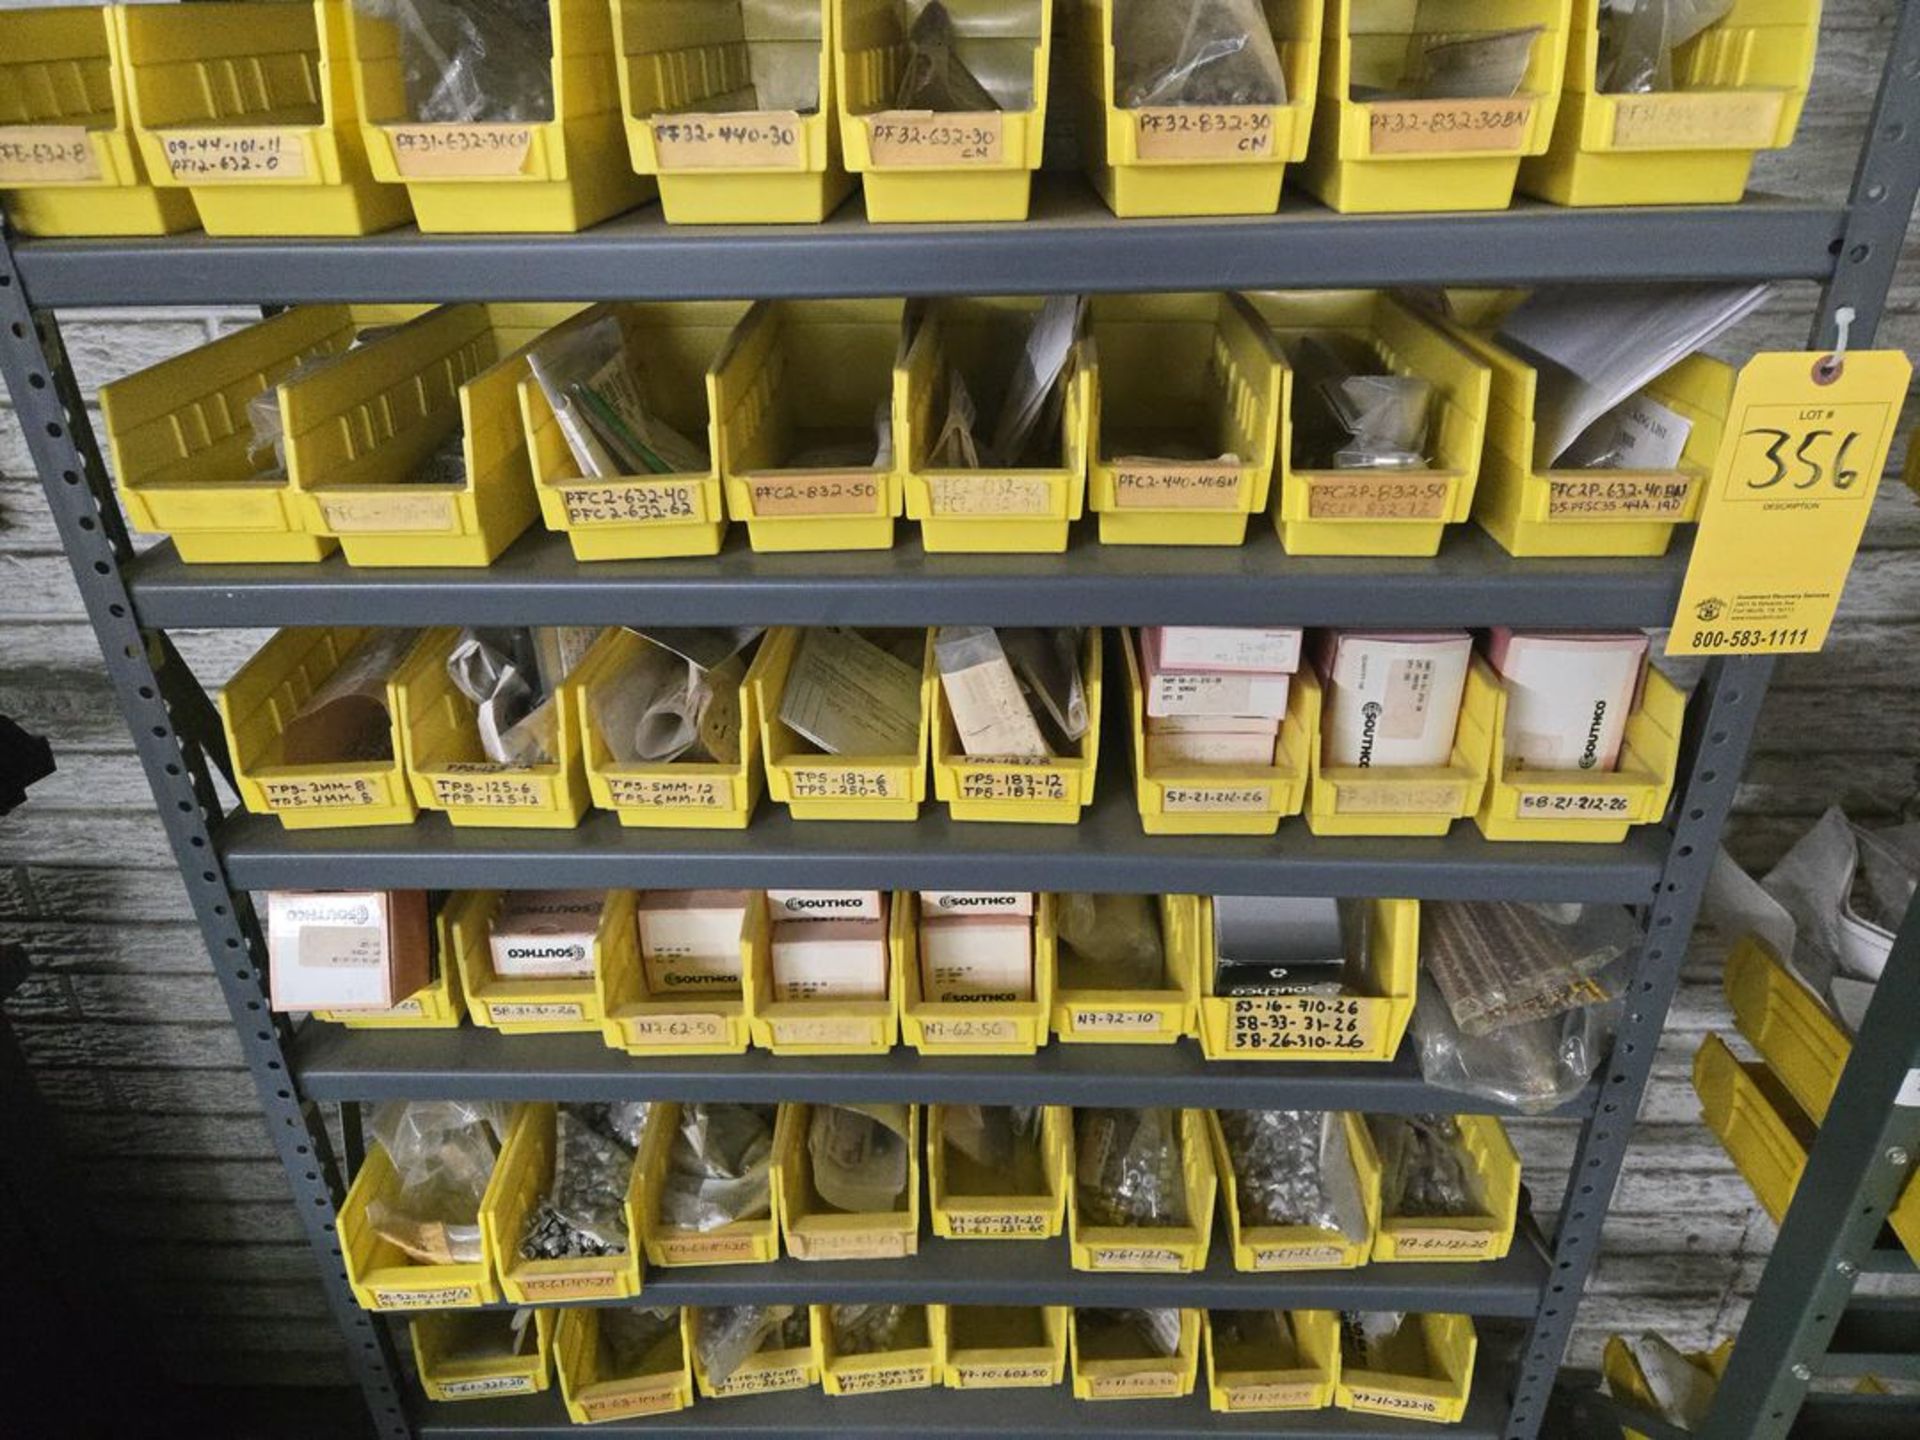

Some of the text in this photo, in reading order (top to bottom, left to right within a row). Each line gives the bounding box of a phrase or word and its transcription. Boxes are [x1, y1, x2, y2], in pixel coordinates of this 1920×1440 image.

[1799, 410, 1826, 421] LOT
[1744, 428, 1861, 490] 356
[1692, 628, 1809, 648] 800-583-1111
[1583, 700, 1607, 760] SOUTHCO
[797, 898, 863, 908] SOUTHCO
[950, 896, 1016, 906] SOUTHCO
[507, 948, 574, 958] SOUTHCO
[675, 974, 739, 984] SOUTHCO
